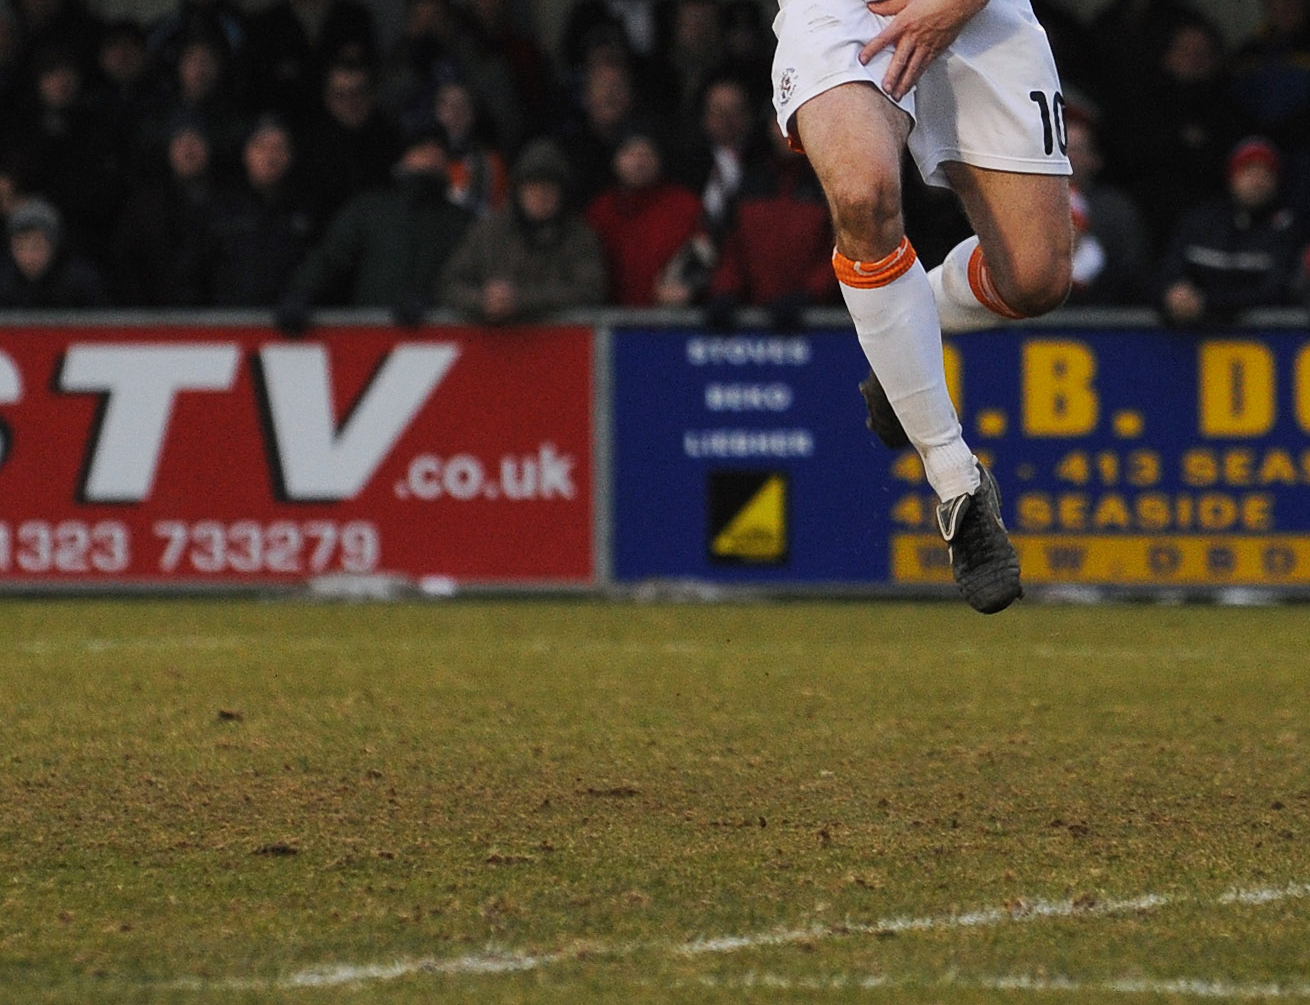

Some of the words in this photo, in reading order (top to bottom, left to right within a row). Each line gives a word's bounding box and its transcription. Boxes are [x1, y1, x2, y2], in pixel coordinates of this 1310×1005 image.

[0, 343, 461, 500] TV
[1017, 496, 1275, 532] SEASIDE
[153, 519, 380, 572] 733279
